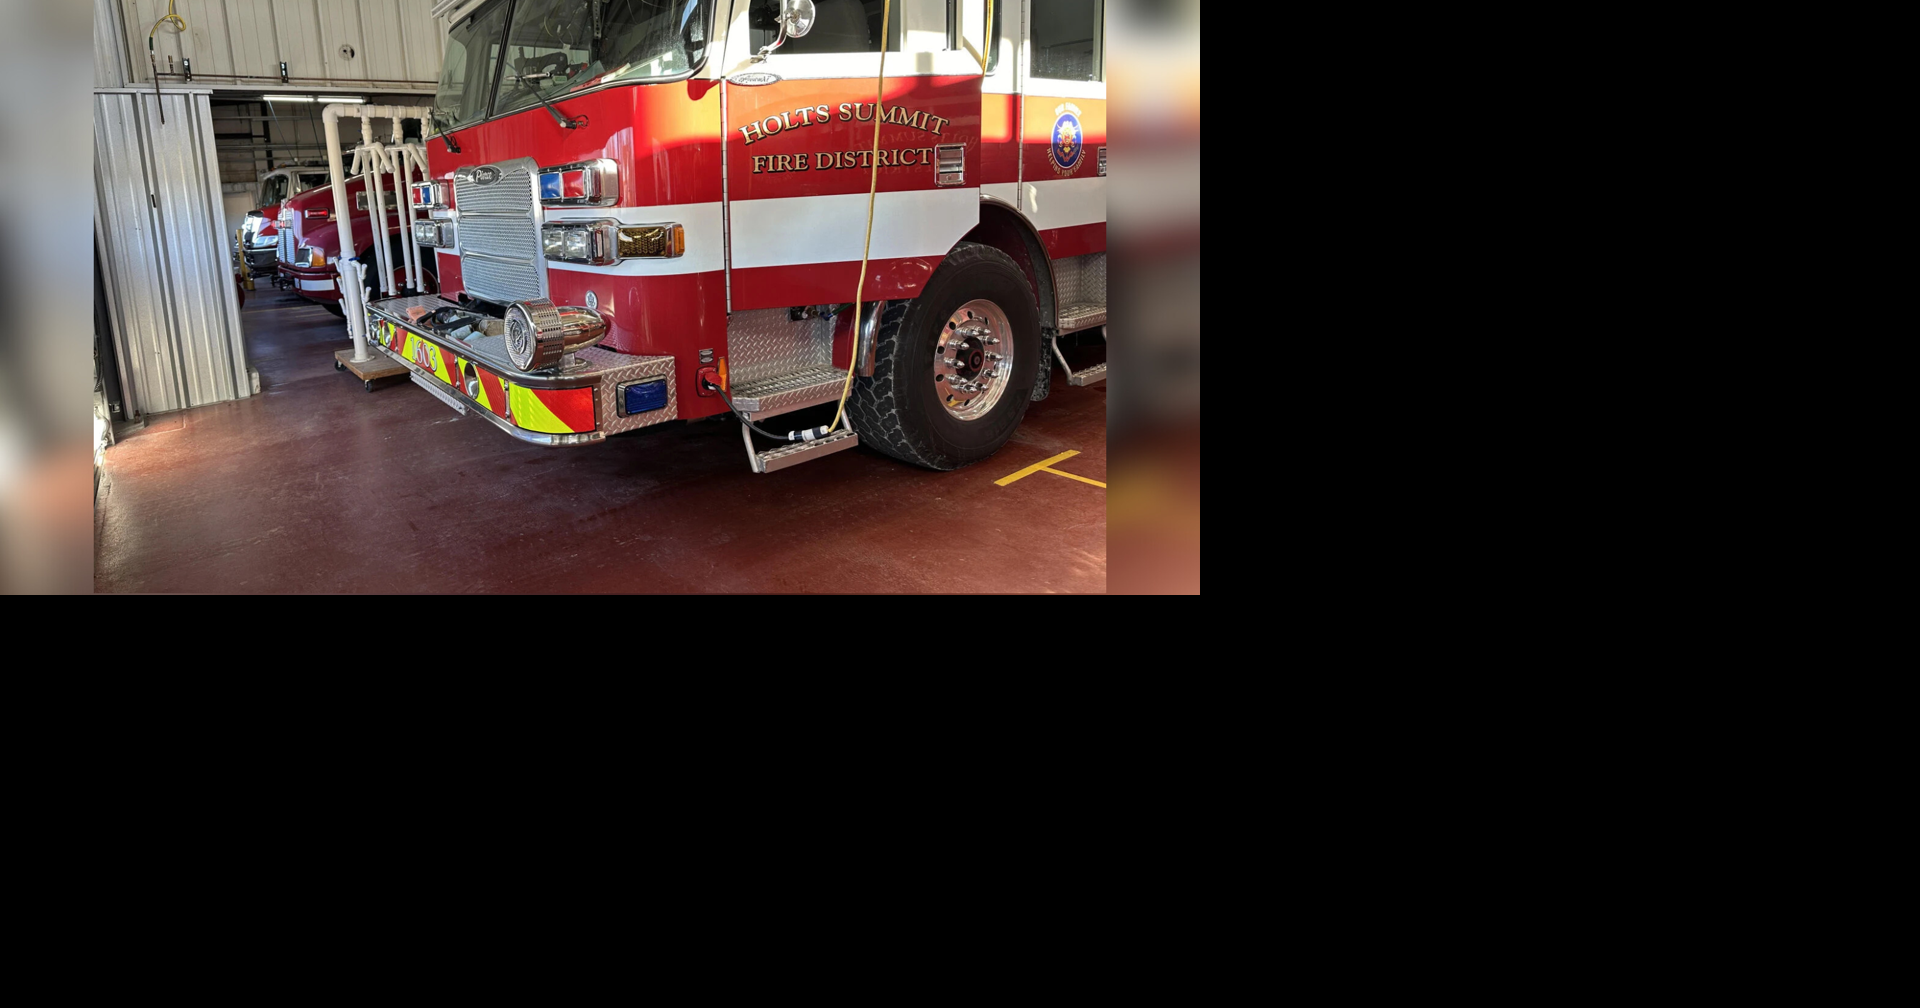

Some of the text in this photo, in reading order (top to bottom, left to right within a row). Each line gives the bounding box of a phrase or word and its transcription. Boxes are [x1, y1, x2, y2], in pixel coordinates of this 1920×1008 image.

[739, 102, 950, 145] HOLTS SUMMIT
[752, 153, 809, 173] FIRE
[815, 148, 934, 170] DISTRICT
[410, 337, 437, 372] 1603
